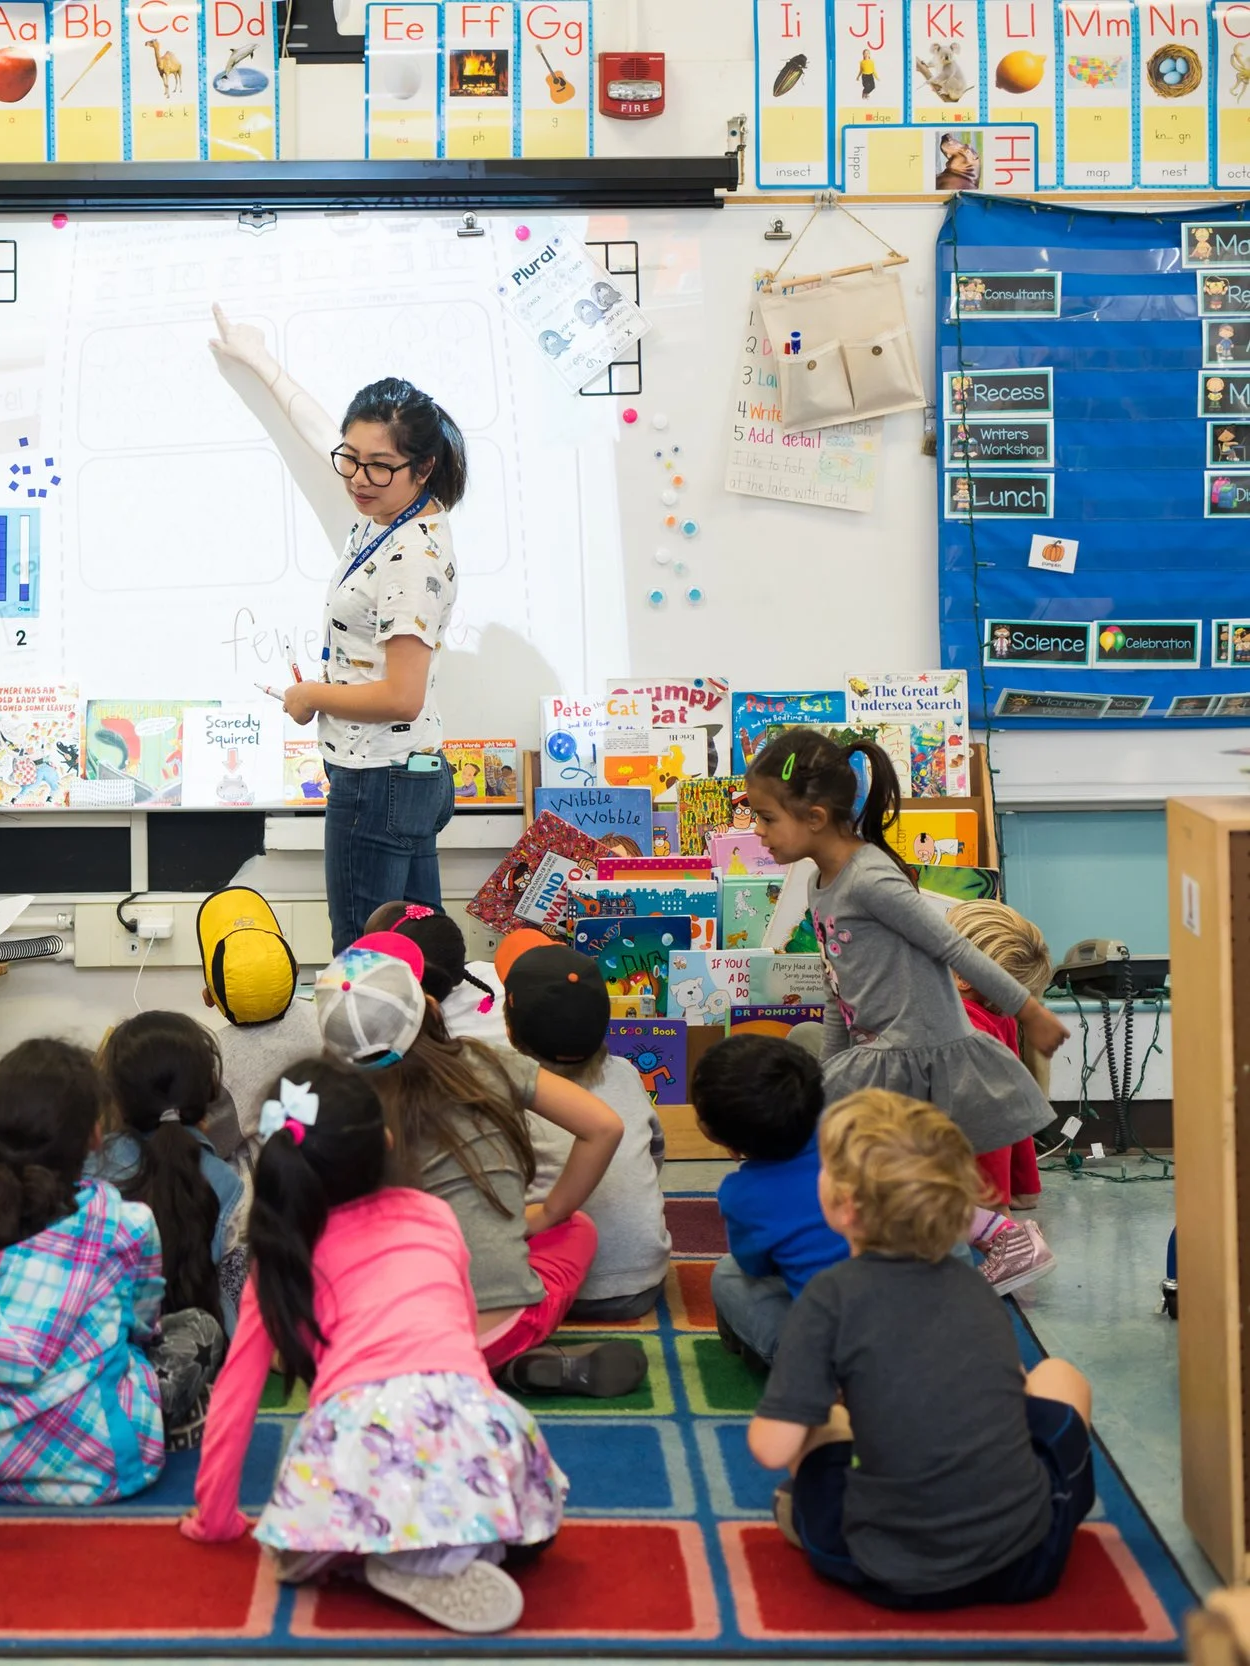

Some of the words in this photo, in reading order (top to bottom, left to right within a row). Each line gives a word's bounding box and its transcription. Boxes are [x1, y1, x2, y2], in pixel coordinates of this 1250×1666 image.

[65, 4, 112, 38] Bb
[137, 0, 189, 33] Cc
[215, 1, 265, 36] Dd
[384, 8, 424, 41] Ee
[462, 5, 505, 38] Ff
[781, 3, 801, 37] Ii
[927, 4, 964, 38] Kk
[1005, 3, 1035, 38] Ll
[1066, 6, 1130, 36] Mm
[1150, 4, 1199, 36] Nn
[526, 5, 583, 56] Gg
[849, 4, 885, 50] Jj
[621, 104, 650, 112] FIRE
[473, 132, 485, 145] ph
[1179, 134, 1191, 144] gn
[849, 146, 865, 179] hippo
[995, 136, 1030, 185] Hh
[776, 165, 812, 177] insect
[1086, 168, 1110, 182] map
[1162, 166, 1189, 177] nest
[511, 245, 557, 286] Plural
[984, 288, 1054, 301] Consultants
[973, 383, 1045, 402] Recess
[748, 427, 774, 445] Add
[980, 428, 1029, 439] Writers
[980, 443, 1044, 457] Workshop
[972, 485, 1046, 507] Lunch
[16, 630, 27, 646] 2
[1012, 632, 1085, 652] Science
[1125, 637, 1191, 649] Celebration
[872, 685, 899, 697] The
[902, 685, 938, 697] Great
[553, 699, 592, 717] Pete
[593, 700, 606, 709] the
[607, 699, 639, 716] Cat
[746, 695, 785, 713] Pete
[800, 695, 832, 712] Cat
[851, 700, 913, 712] Undersea
[916, 699, 961, 711] Search
[1036, 696, 1096, 709] Morning
[205, 714, 261, 731] Scaredy
[773, 713, 802, 721] Bedtime
[206, 730, 260, 748] Squirrel
[550, 791, 613, 812] Wibble
[575, 809, 642, 826] Wobble
[535, 873, 564, 911] FIND
[712, 959, 721, 969] IF
[725, 960, 742, 969] YOU
[773, 963, 791, 971] Mary
[793, 963, 805, 971] Had
[758, 1008, 806, 1016] POMPO'S
[653, 1027, 677, 1035] Book
